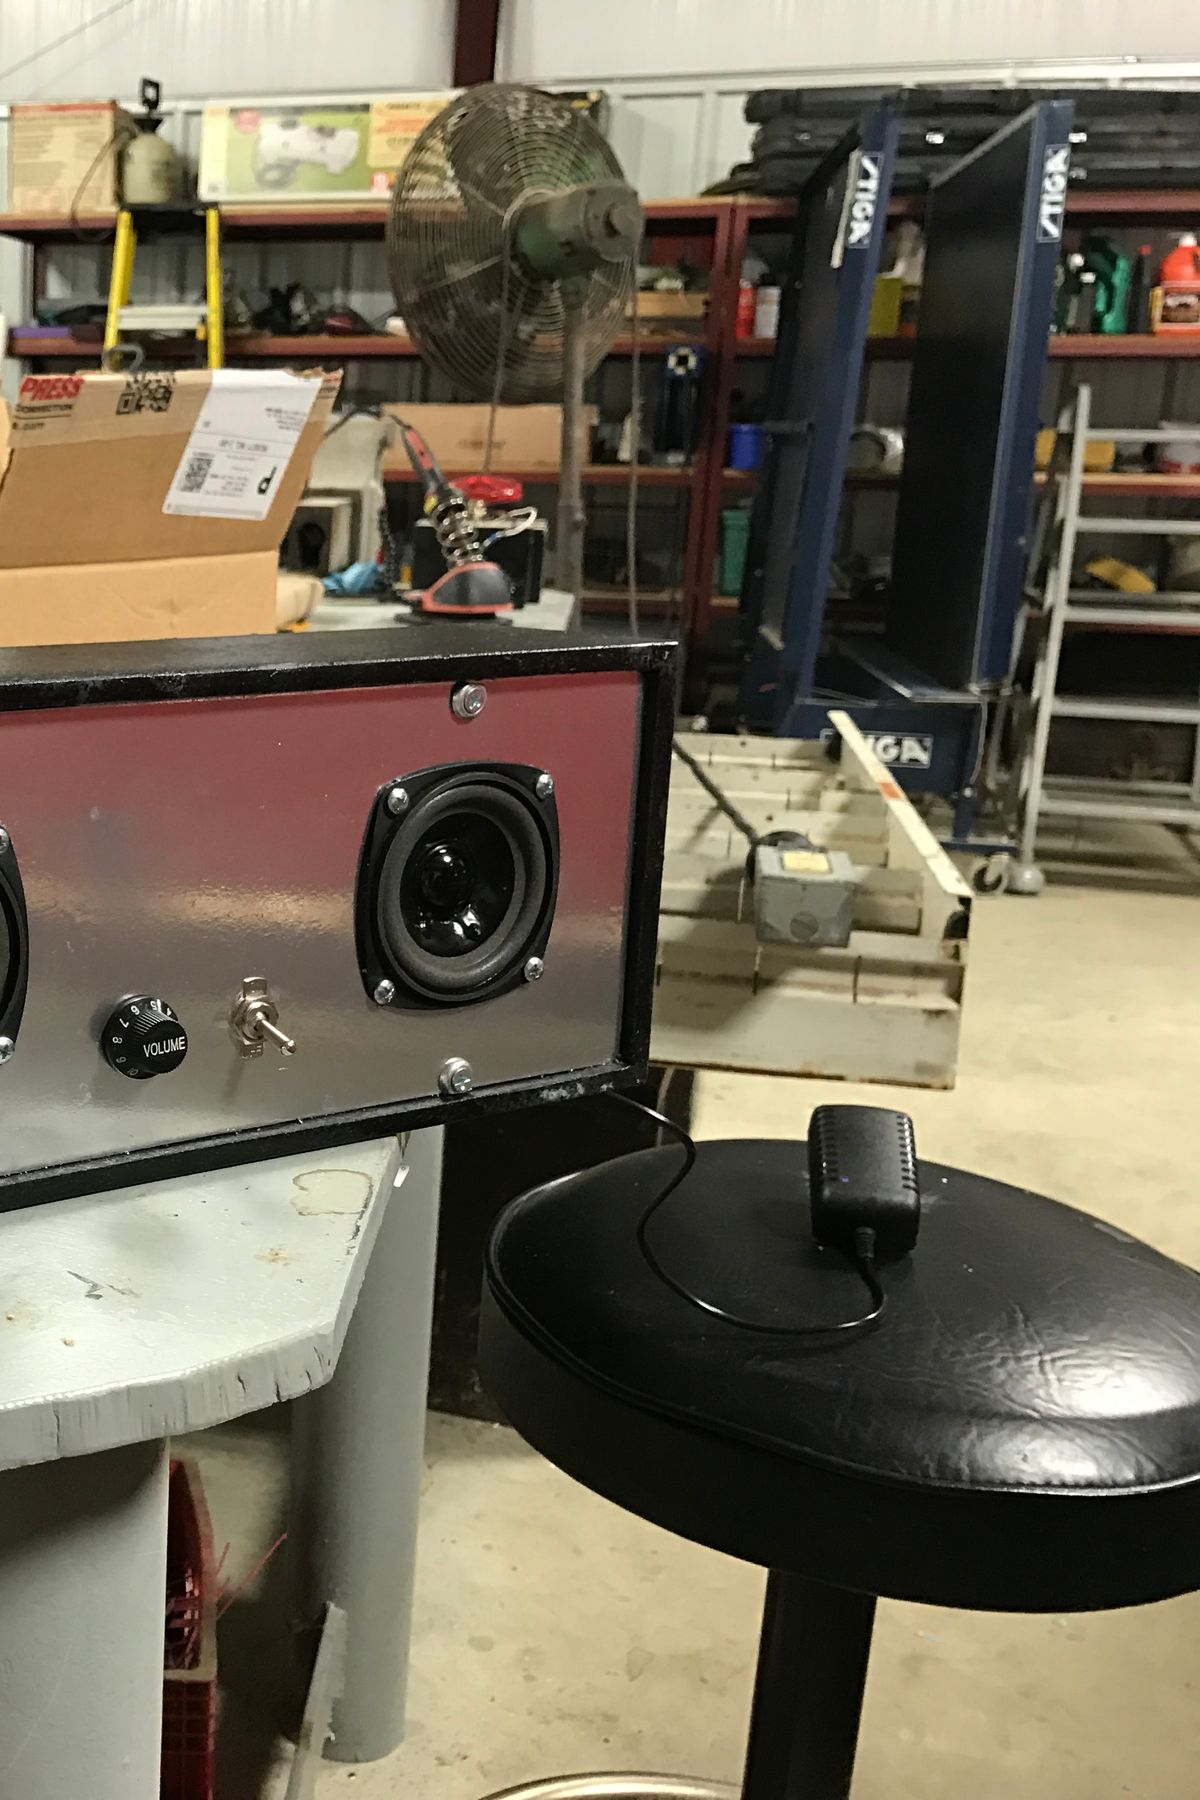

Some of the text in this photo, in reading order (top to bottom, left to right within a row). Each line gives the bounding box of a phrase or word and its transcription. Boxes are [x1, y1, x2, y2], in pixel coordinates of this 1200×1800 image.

[119, 1018, 129, 1028] 7
[112, 1036, 123, 1044] 8
[143, 1036, 186, 1057] VOLUME
